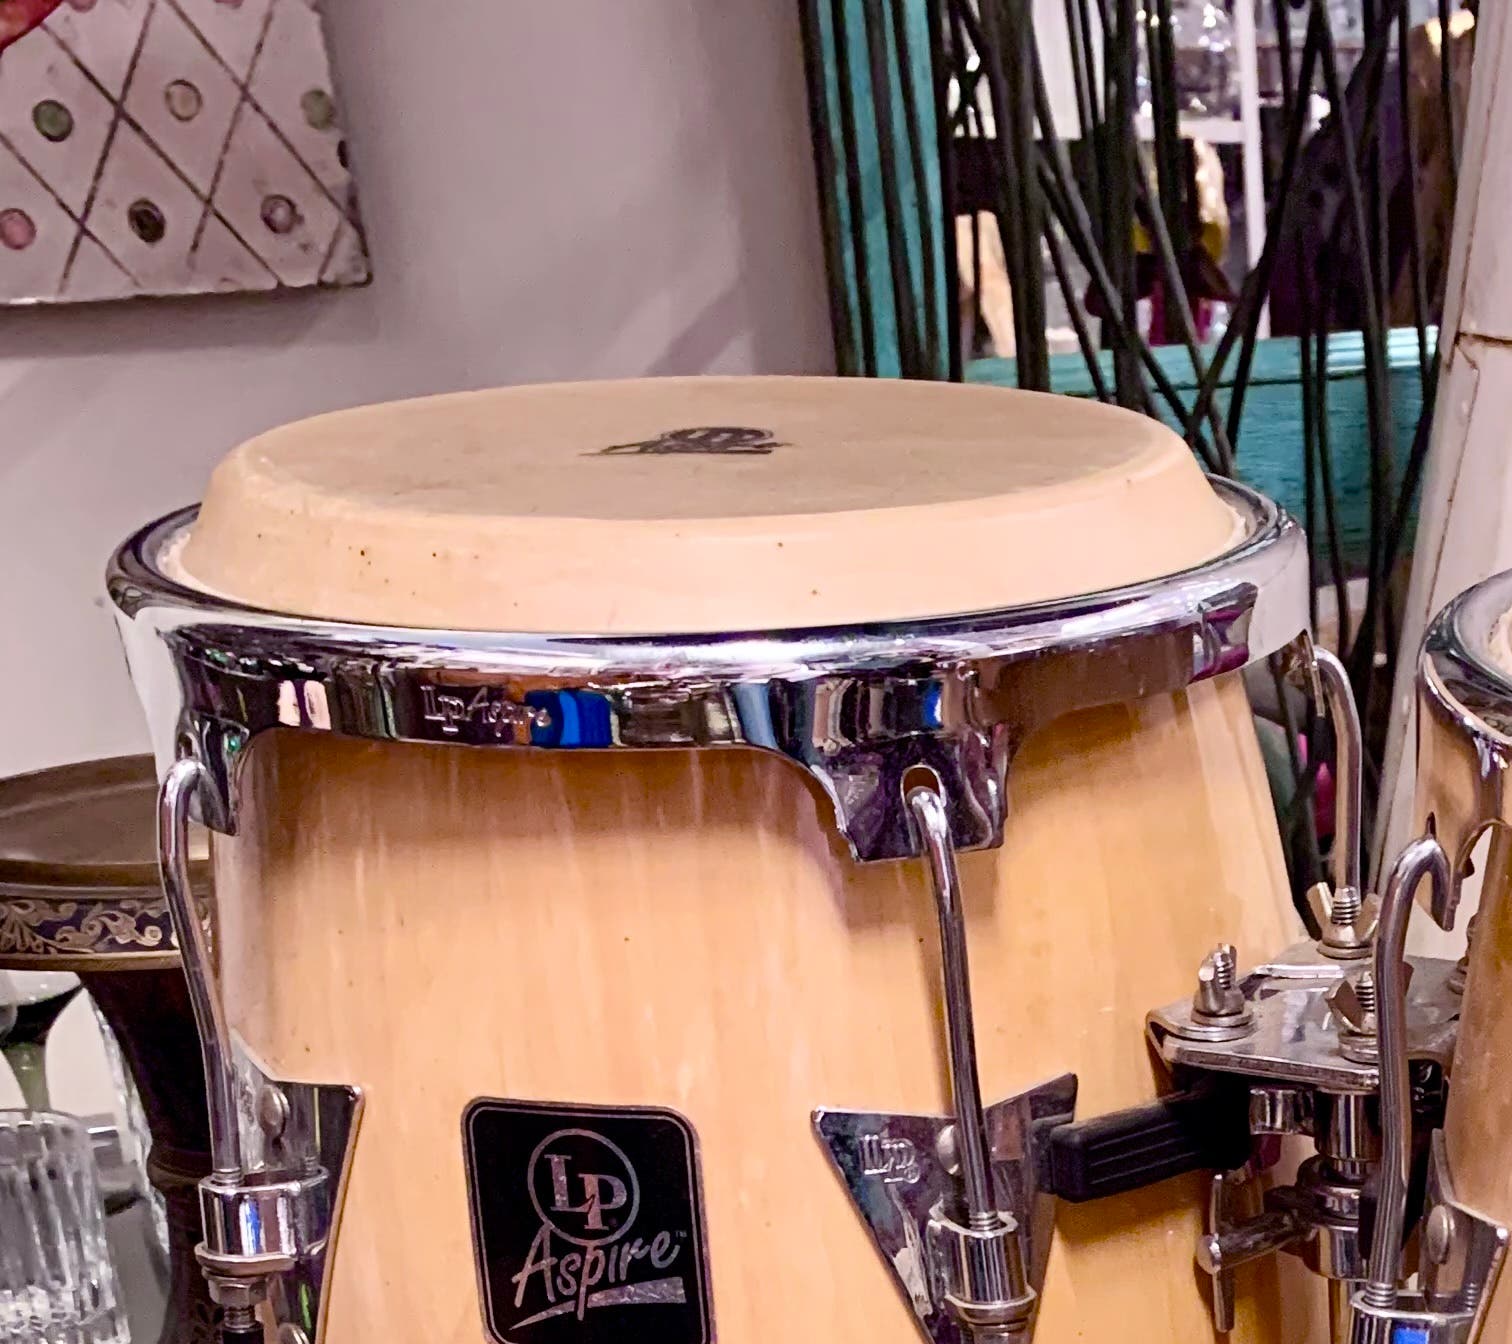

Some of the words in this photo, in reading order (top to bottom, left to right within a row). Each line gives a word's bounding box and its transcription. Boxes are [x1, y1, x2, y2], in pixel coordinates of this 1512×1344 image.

[420, 685, 465, 735] LP
[543, 1153, 628, 1231] LP
[511, 1222, 680, 1321] Aspire
